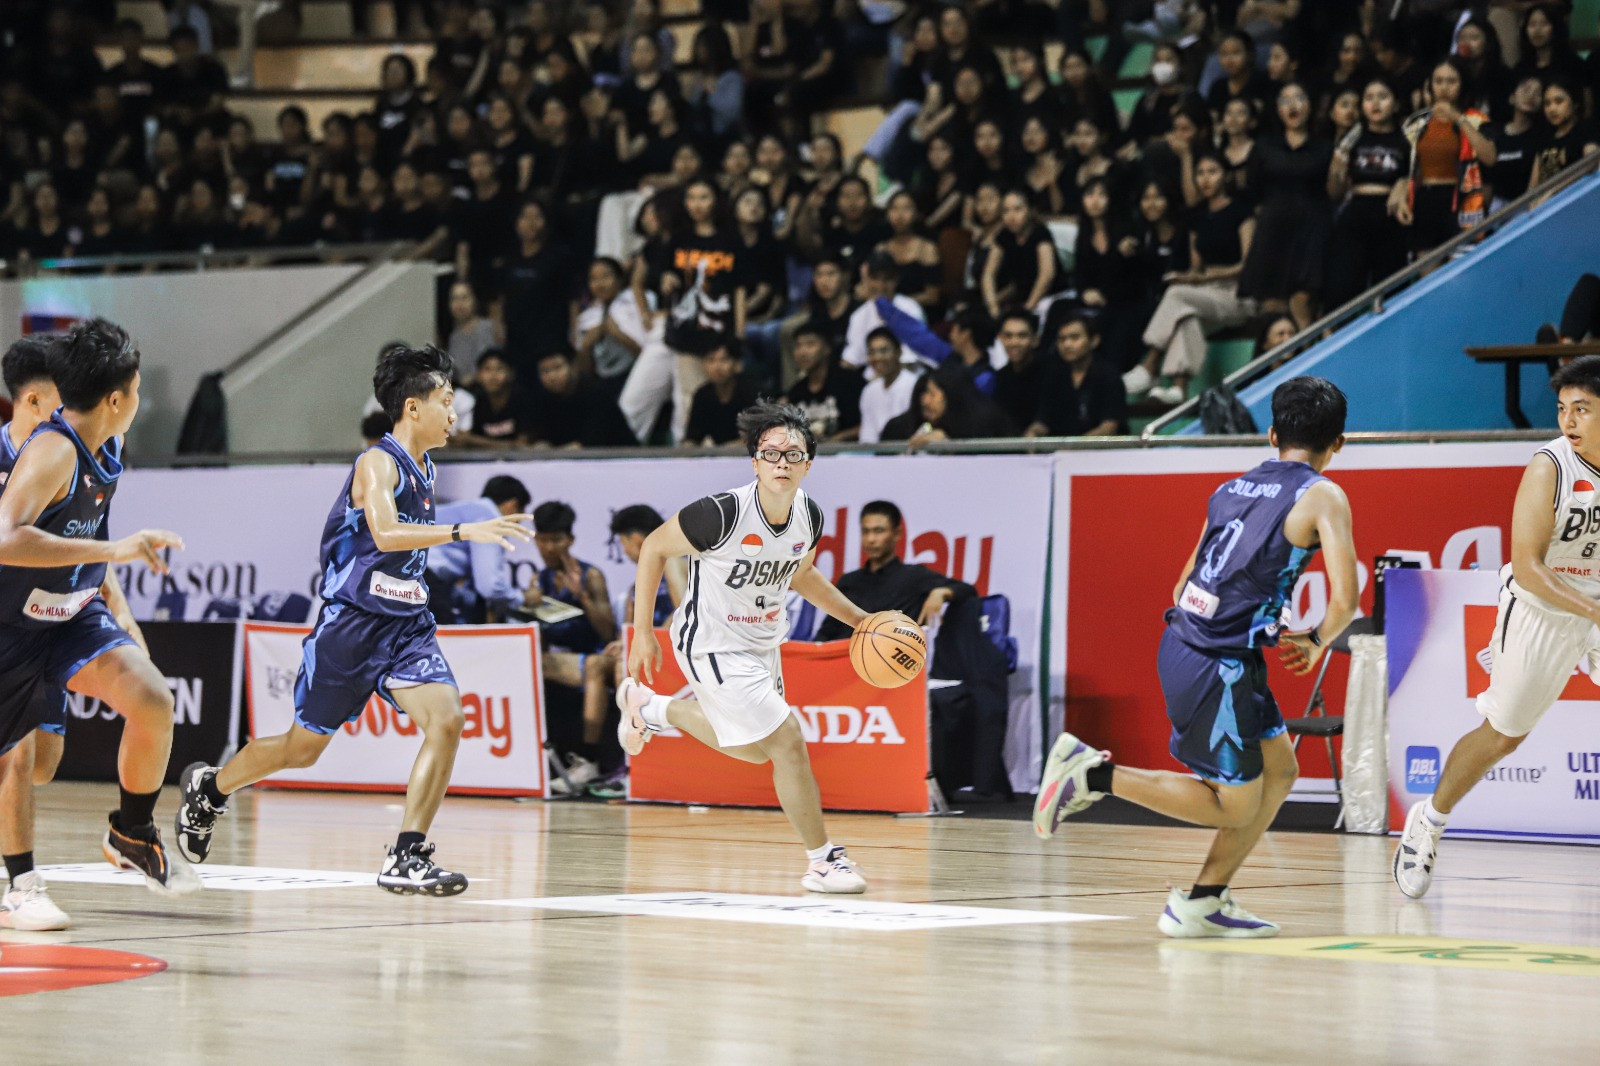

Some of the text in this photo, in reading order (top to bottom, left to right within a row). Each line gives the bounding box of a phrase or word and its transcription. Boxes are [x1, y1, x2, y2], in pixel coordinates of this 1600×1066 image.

[117, 546, 257, 599] ackson
[417, 653, 448, 677] 23
[891, 646, 917, 671] DBL
[790, 705, 906, 744] NDA
[1409, 758, 1438, 775] DBL
